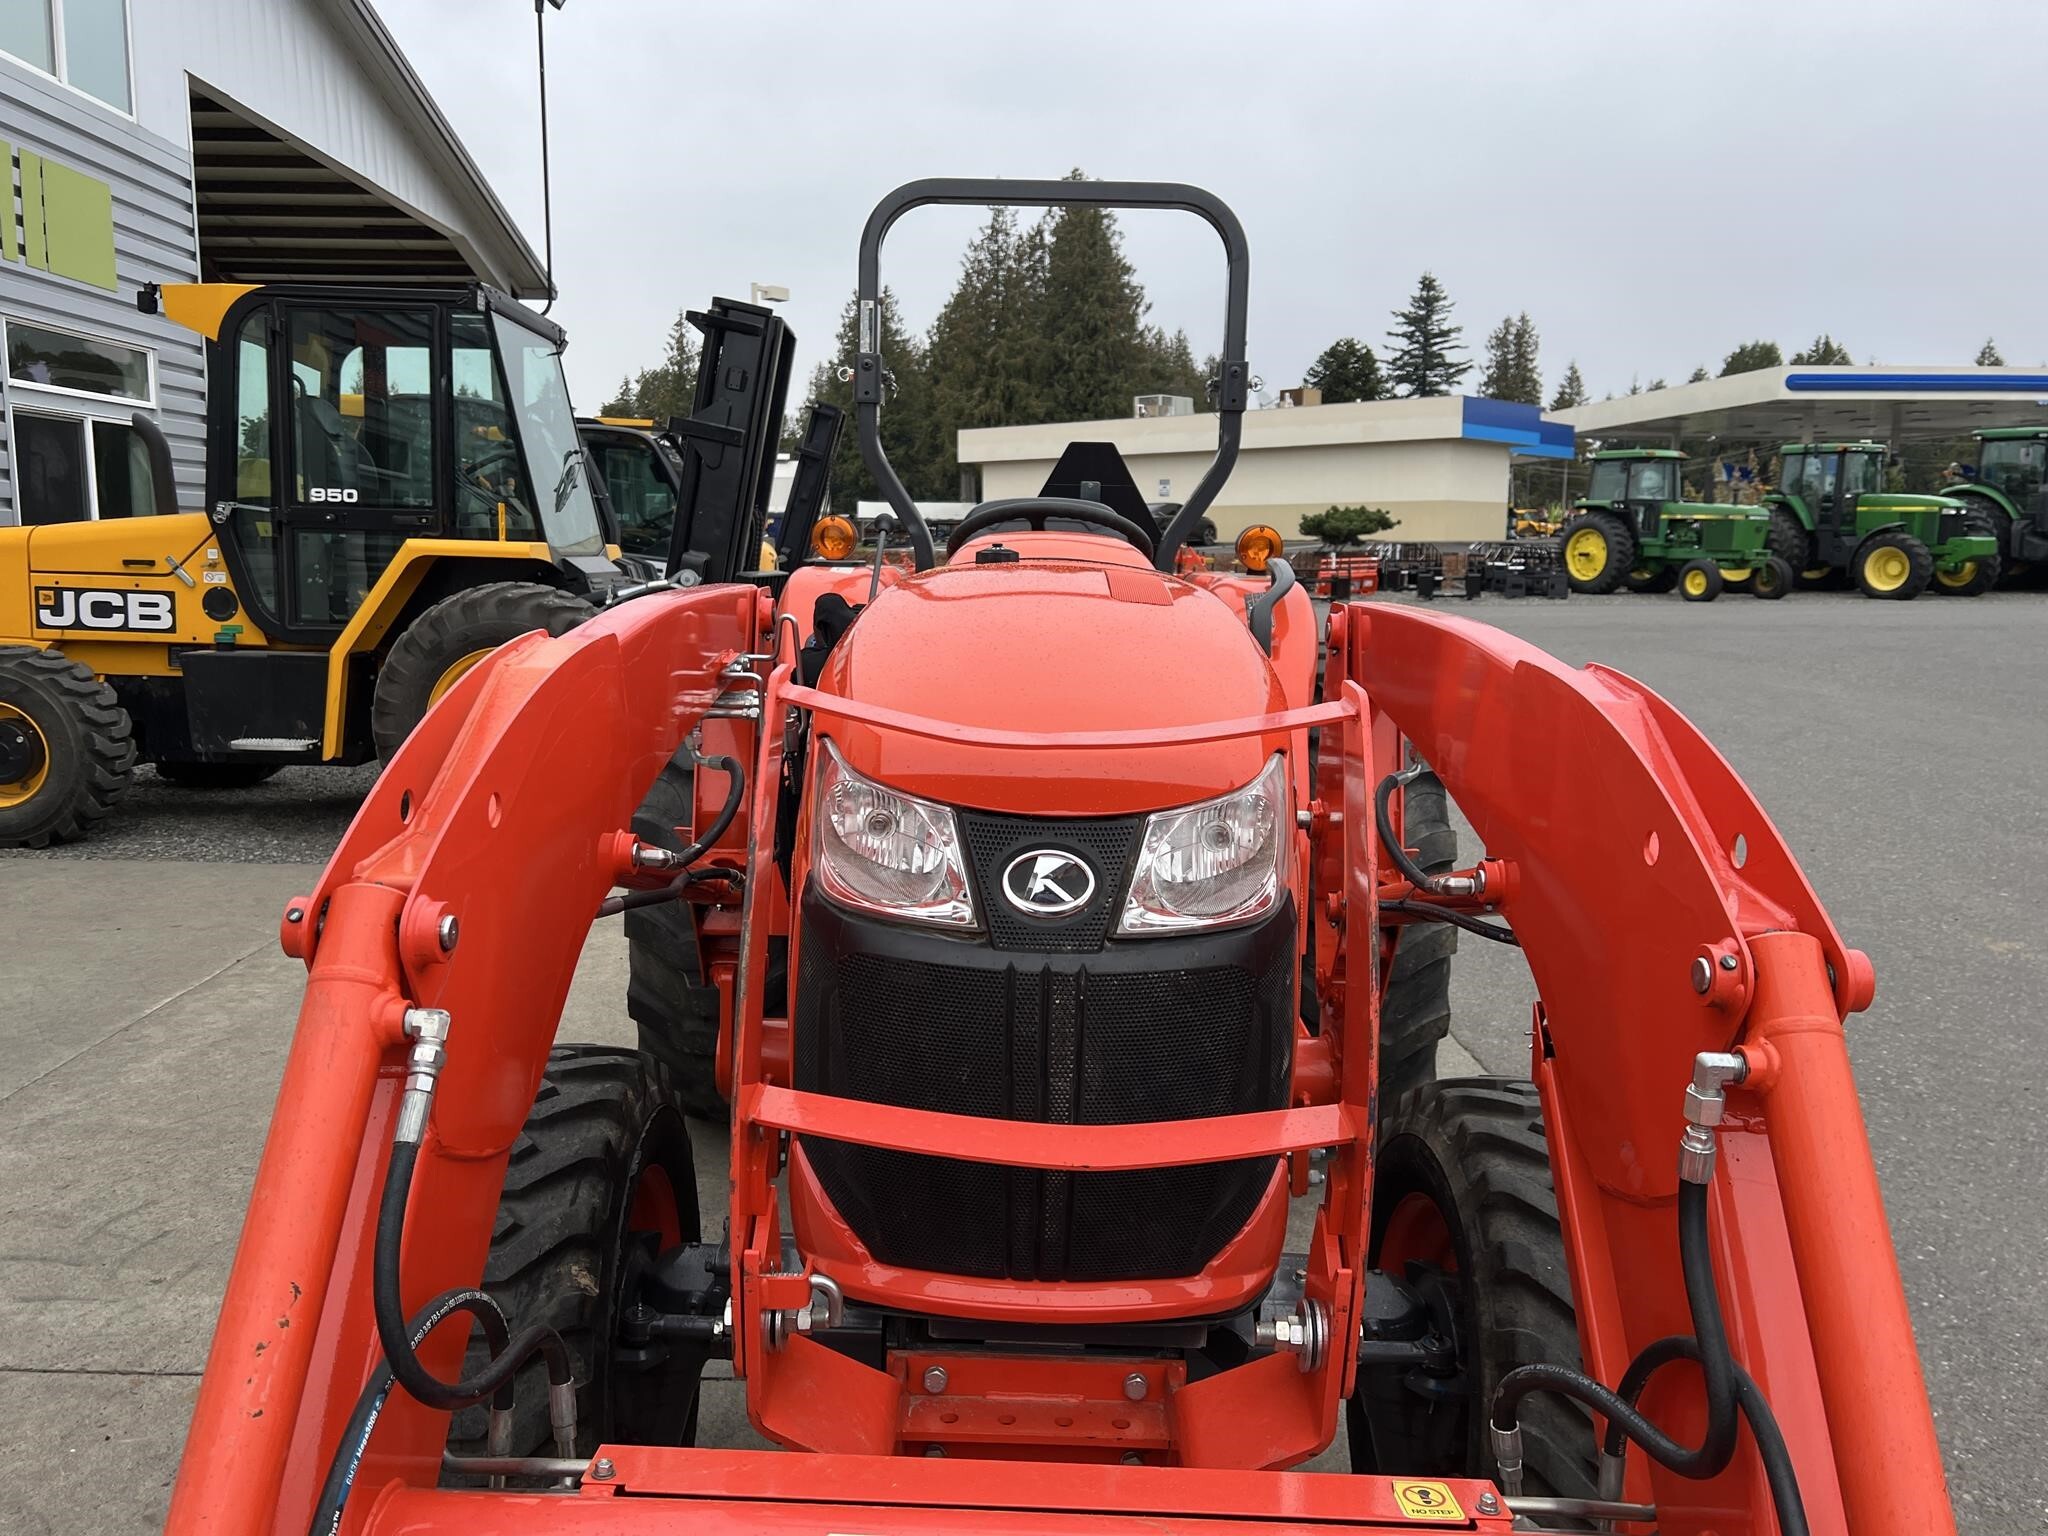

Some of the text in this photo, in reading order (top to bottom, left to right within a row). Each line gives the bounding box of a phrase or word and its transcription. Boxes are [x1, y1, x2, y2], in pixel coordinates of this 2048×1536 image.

[310, 487, 358, 503] 950
[39, 590, 174, 630] JCB
[356, 1411, 379, 1459] Mega3000
